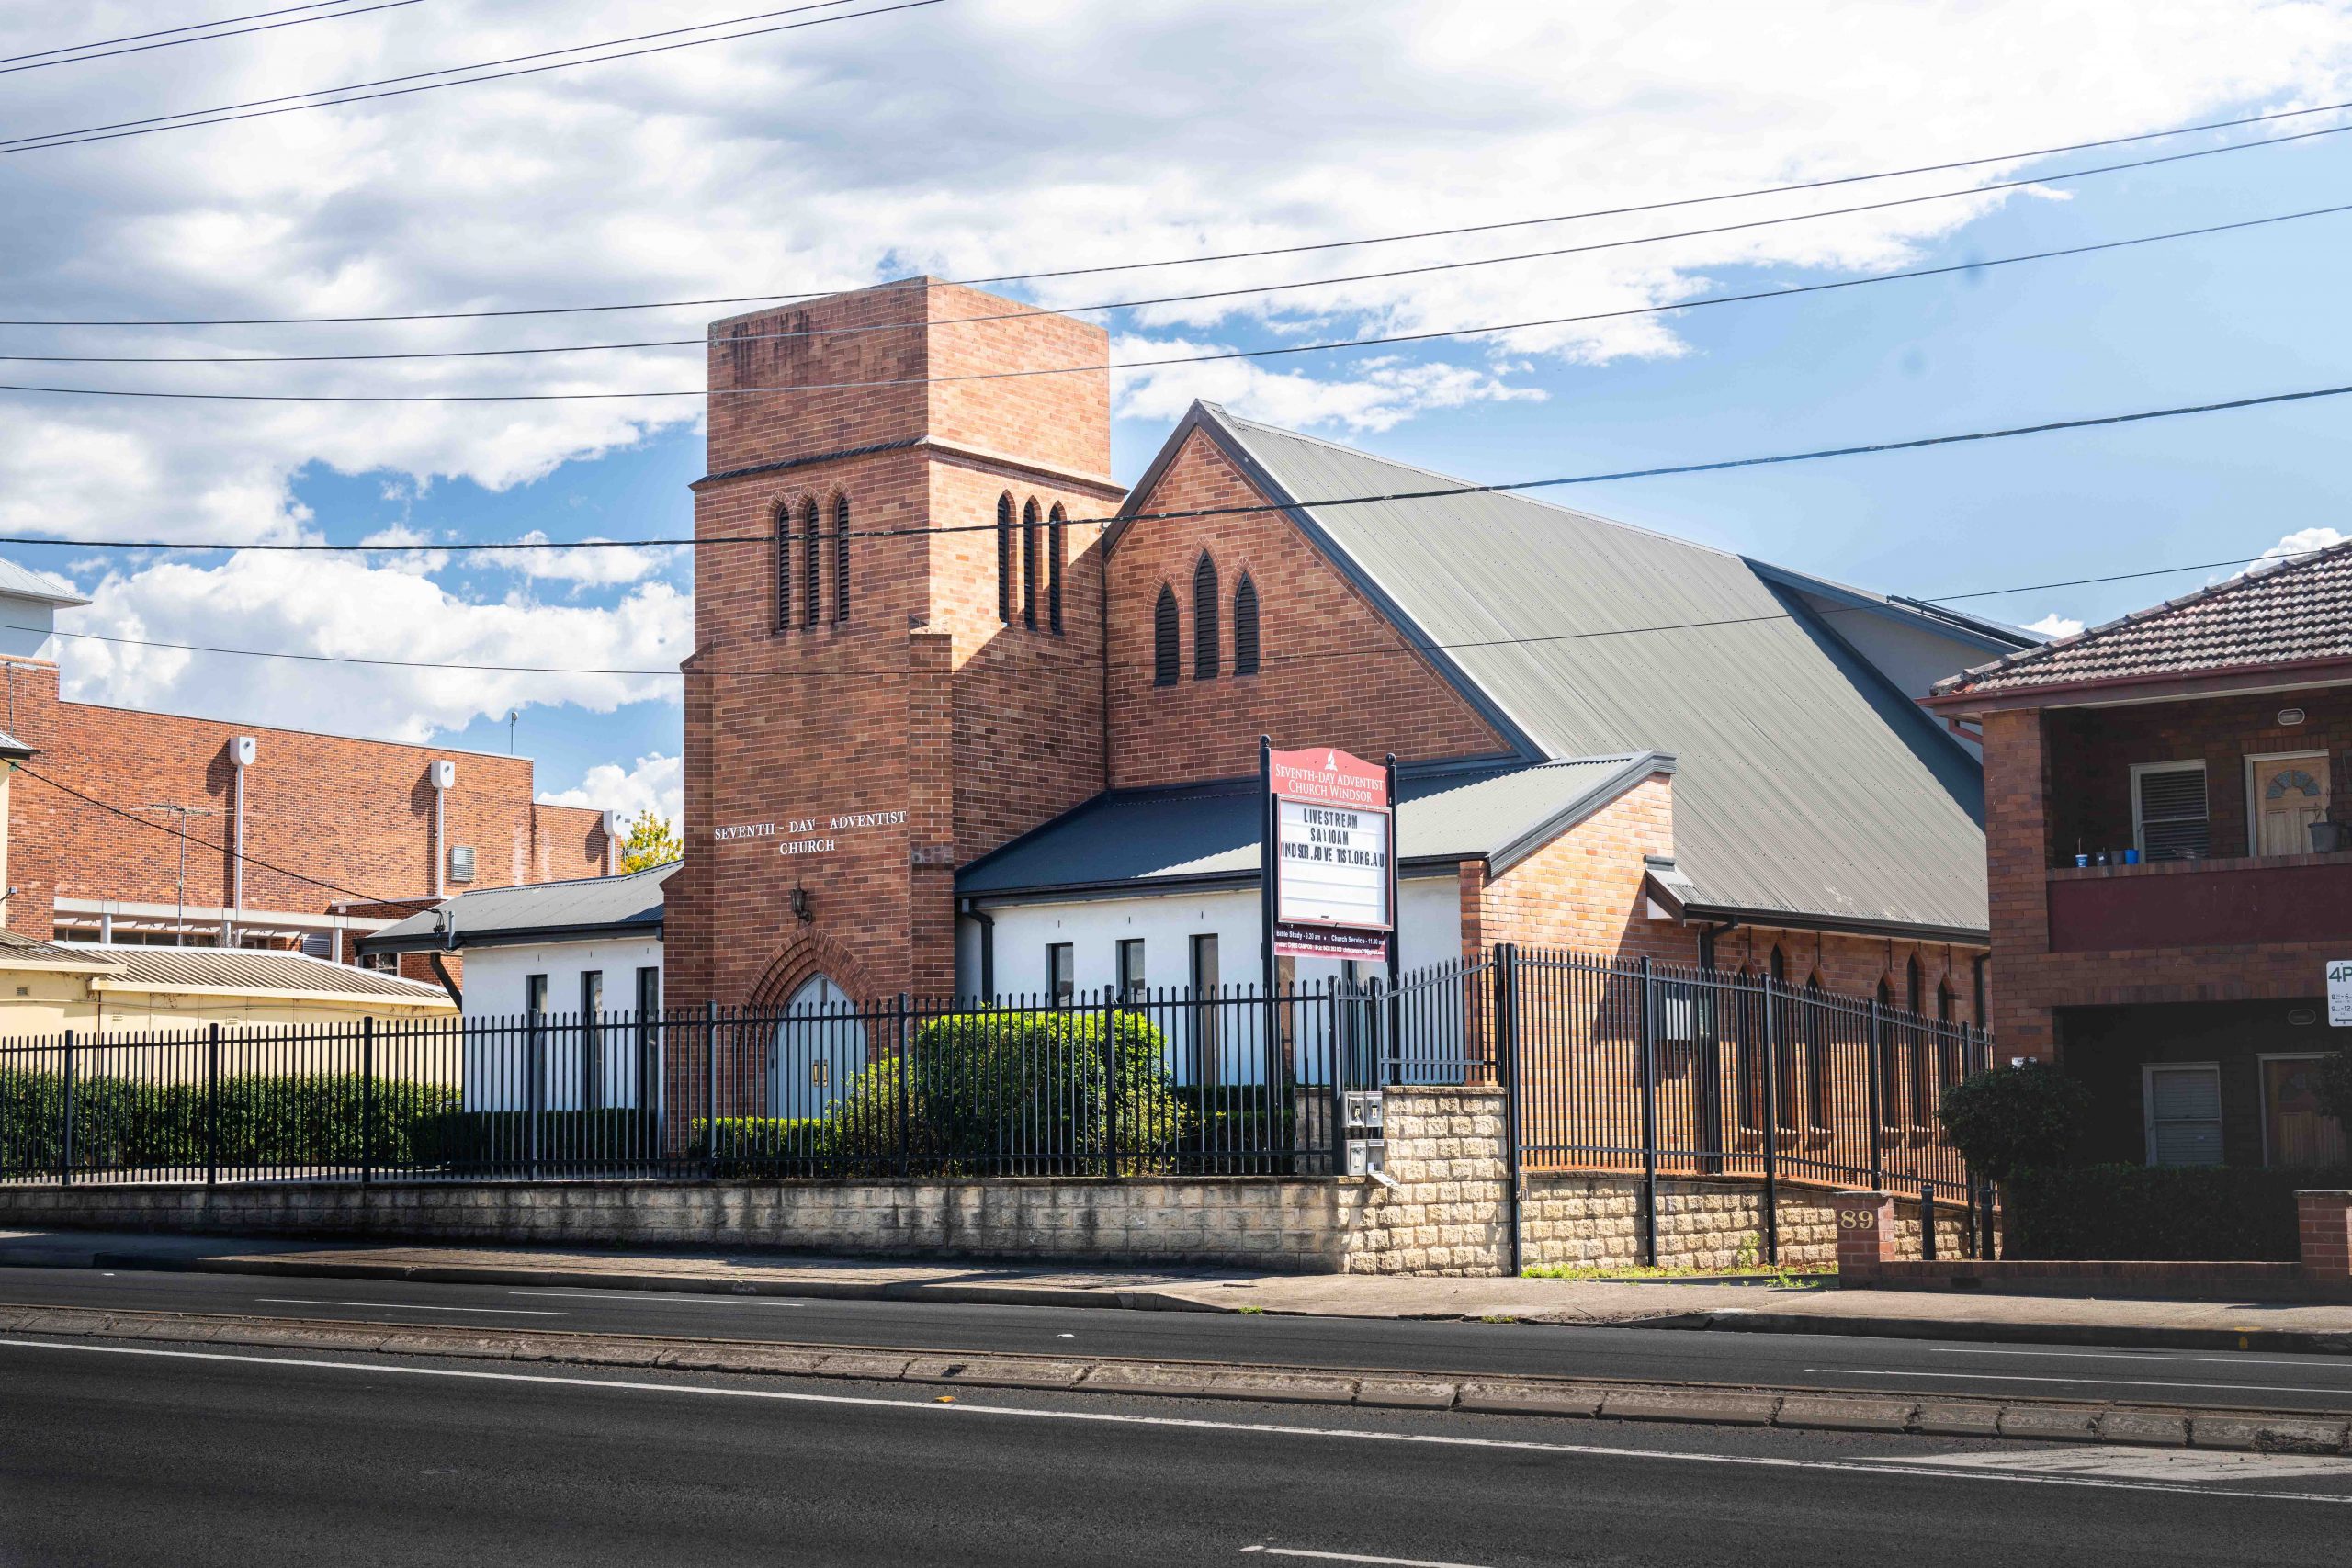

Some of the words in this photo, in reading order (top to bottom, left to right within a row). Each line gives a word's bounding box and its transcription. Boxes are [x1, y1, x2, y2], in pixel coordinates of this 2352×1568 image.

[1275, 763, 1335, 784] SEVENTH-DAY
[1337, 773, 1384, 791] ADVENTIST
[1288, 779, 1328, 797] CHURCH
[1329, 784, 1373, 802] WINDSOR
[715, 823, 775, 840] SEVENTH
[789, 818, 816, 833] DAY
[830, 810, 907, 829] ADVENTIST
[1304, 808, 1357, 829] LIVESTREAM
[780, 839, 835, 855] CHURCH
[1289, 931, 1303, 940] Study
[2329, 967, 2352, 982] 4P
[1840, 1210, 1874, 1229] 89
